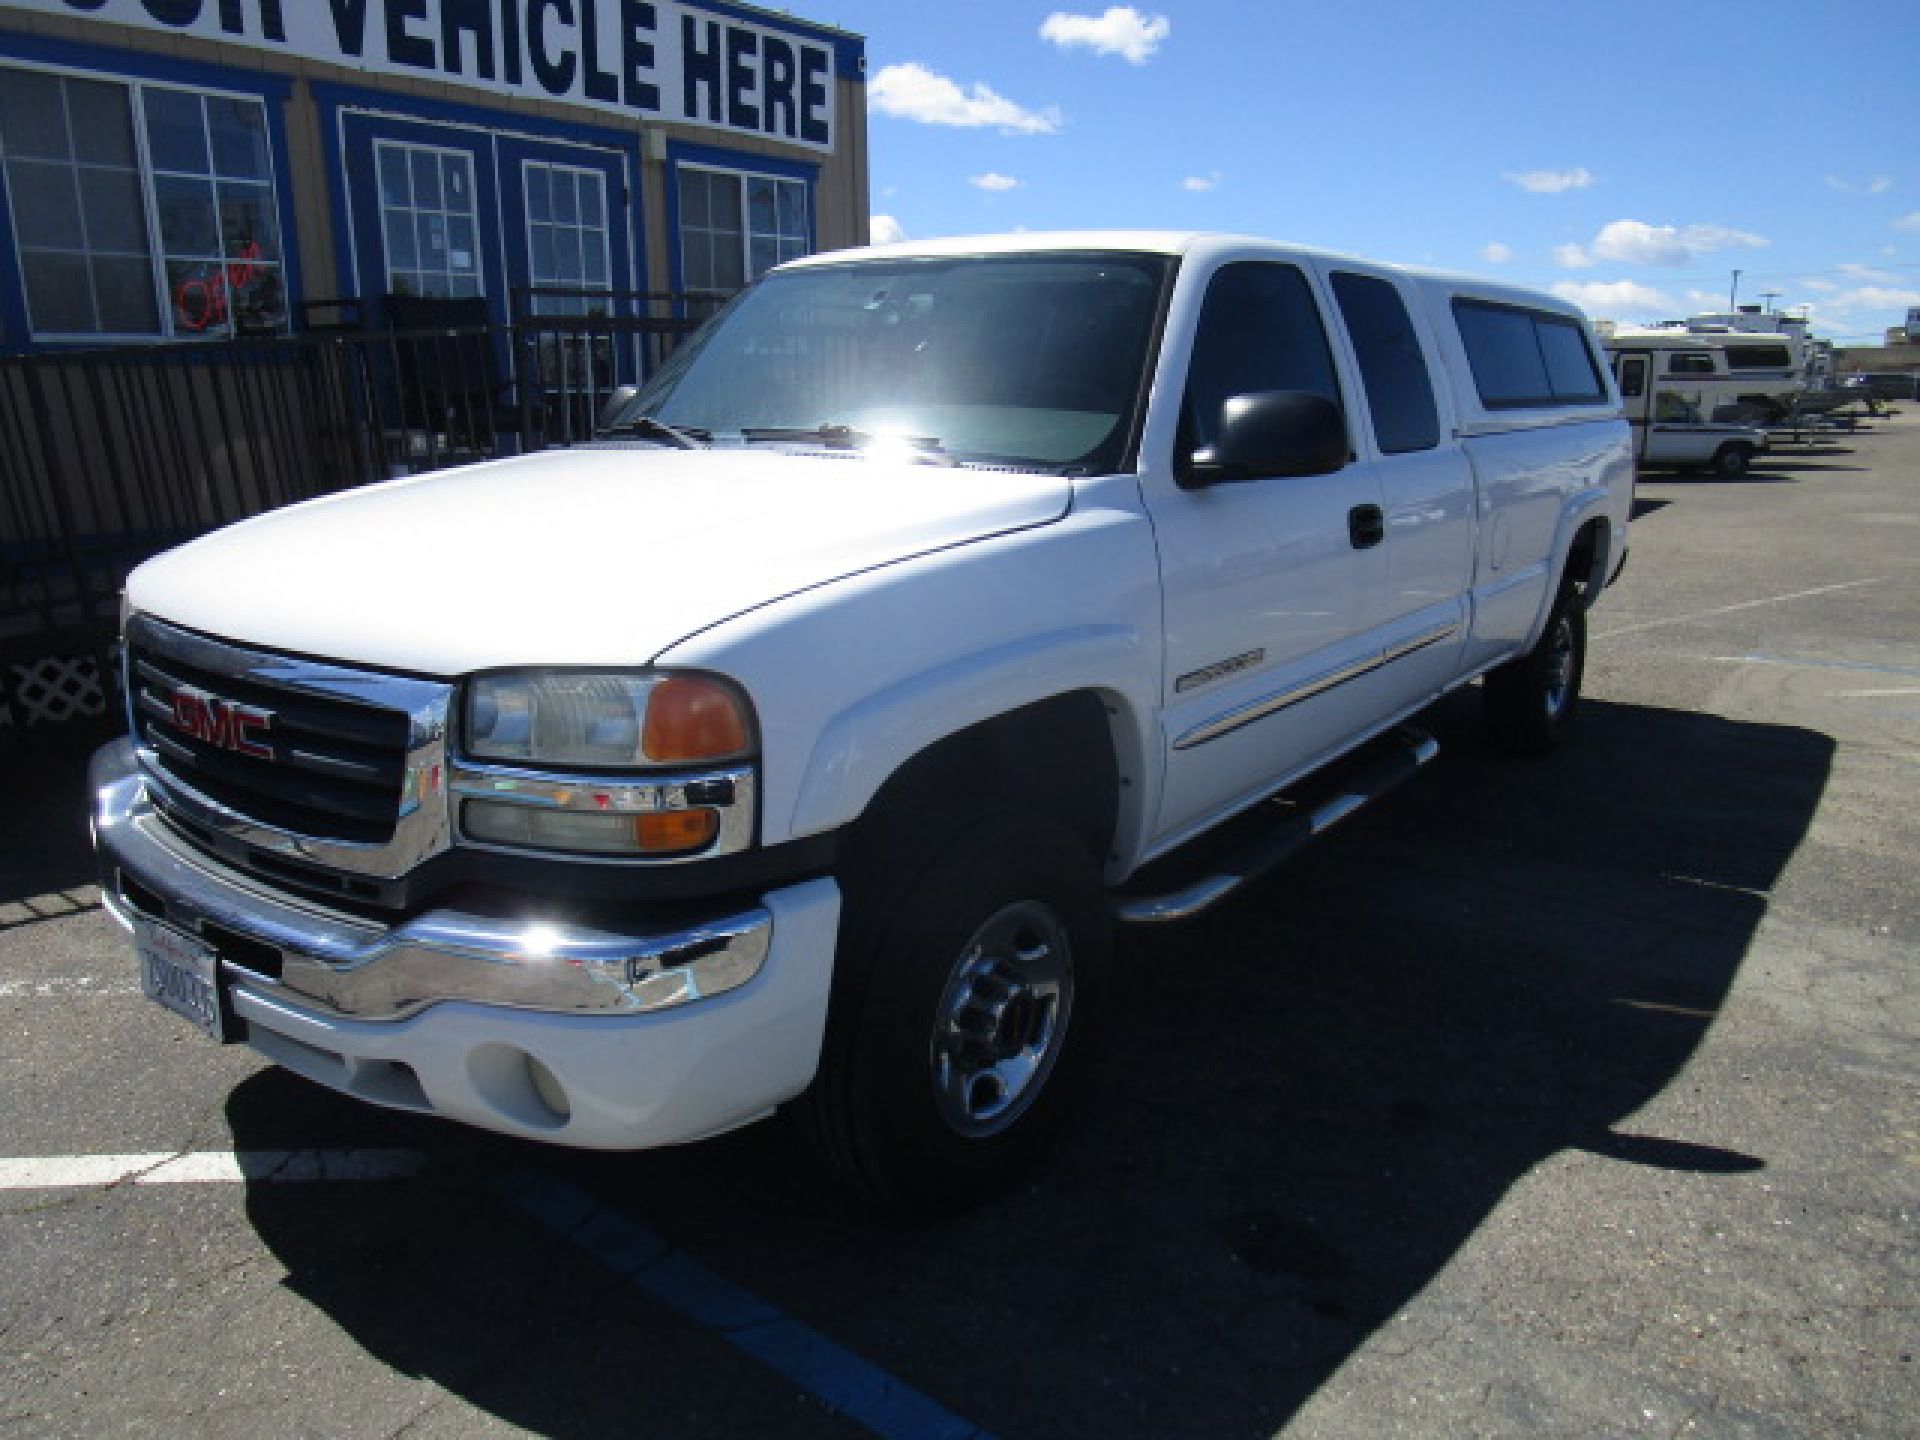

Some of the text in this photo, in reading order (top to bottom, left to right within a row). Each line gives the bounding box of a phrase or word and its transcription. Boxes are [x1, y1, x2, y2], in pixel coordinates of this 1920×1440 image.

[329, 0, 829, 145] VEHICLE HERE
[168, 684, 274, 760] GMC
